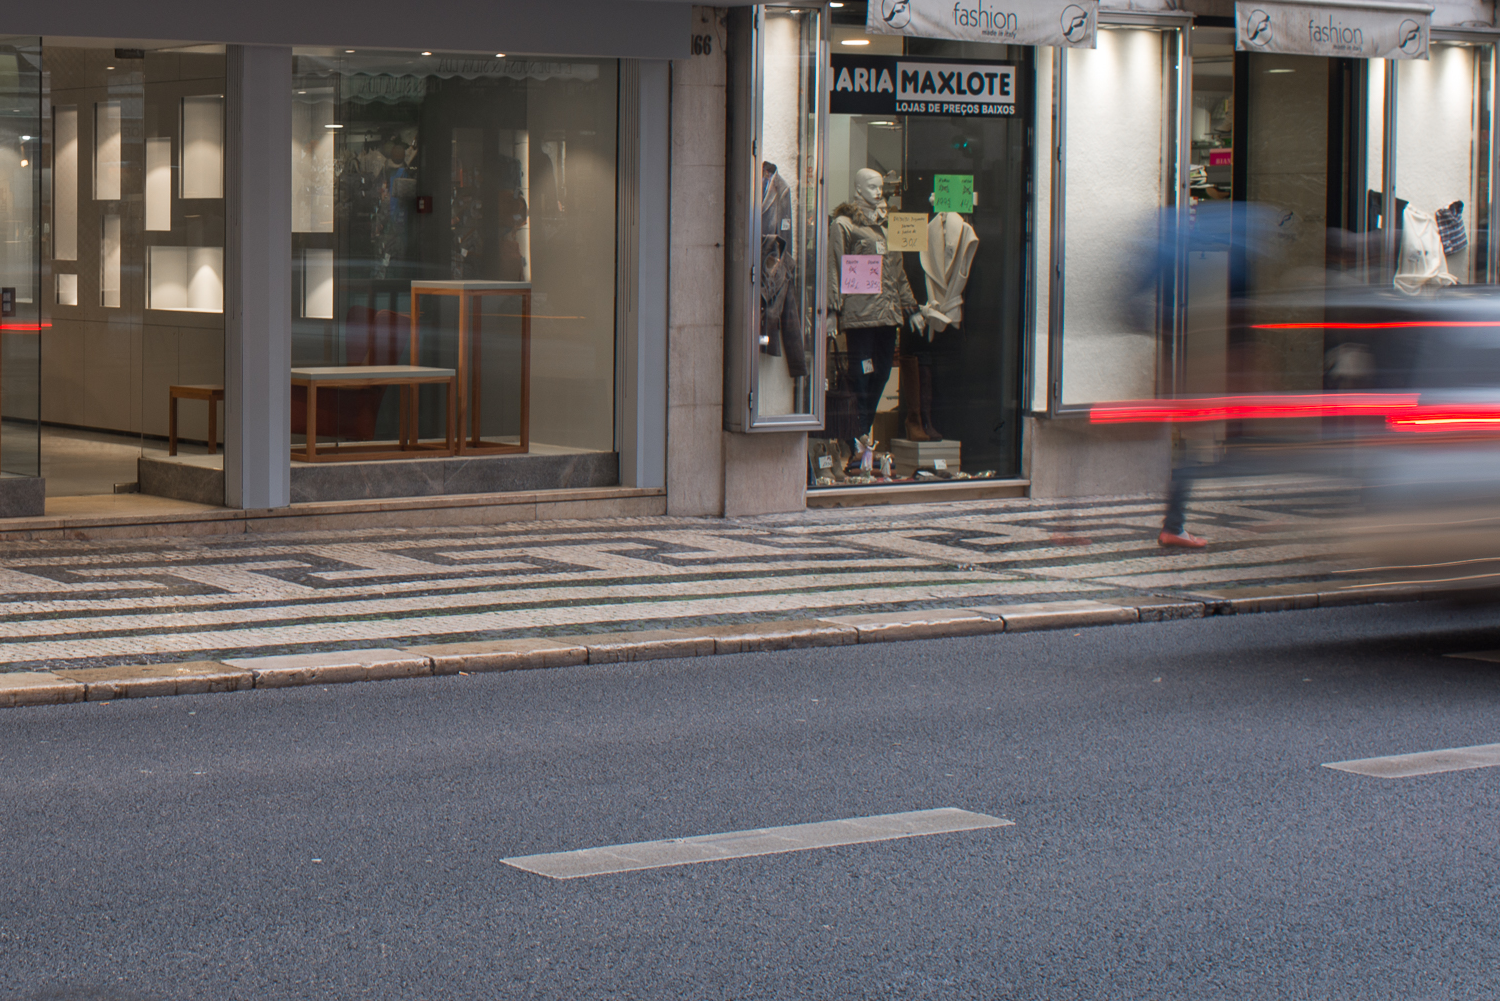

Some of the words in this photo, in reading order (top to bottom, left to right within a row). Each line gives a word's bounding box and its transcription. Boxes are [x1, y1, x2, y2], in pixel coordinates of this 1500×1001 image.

[982, 29, 997, 37] made
[1308, 14, 1364, 45] fashion
[901, 69, 1011, 97] MAXLOTE
[896, 102, 926, 113] LOJAS
[928, 103, 941, 114] DE
[943, 104, 979, 116] PREÇOS
[982, 105, 1015, 115] BAIXOS
